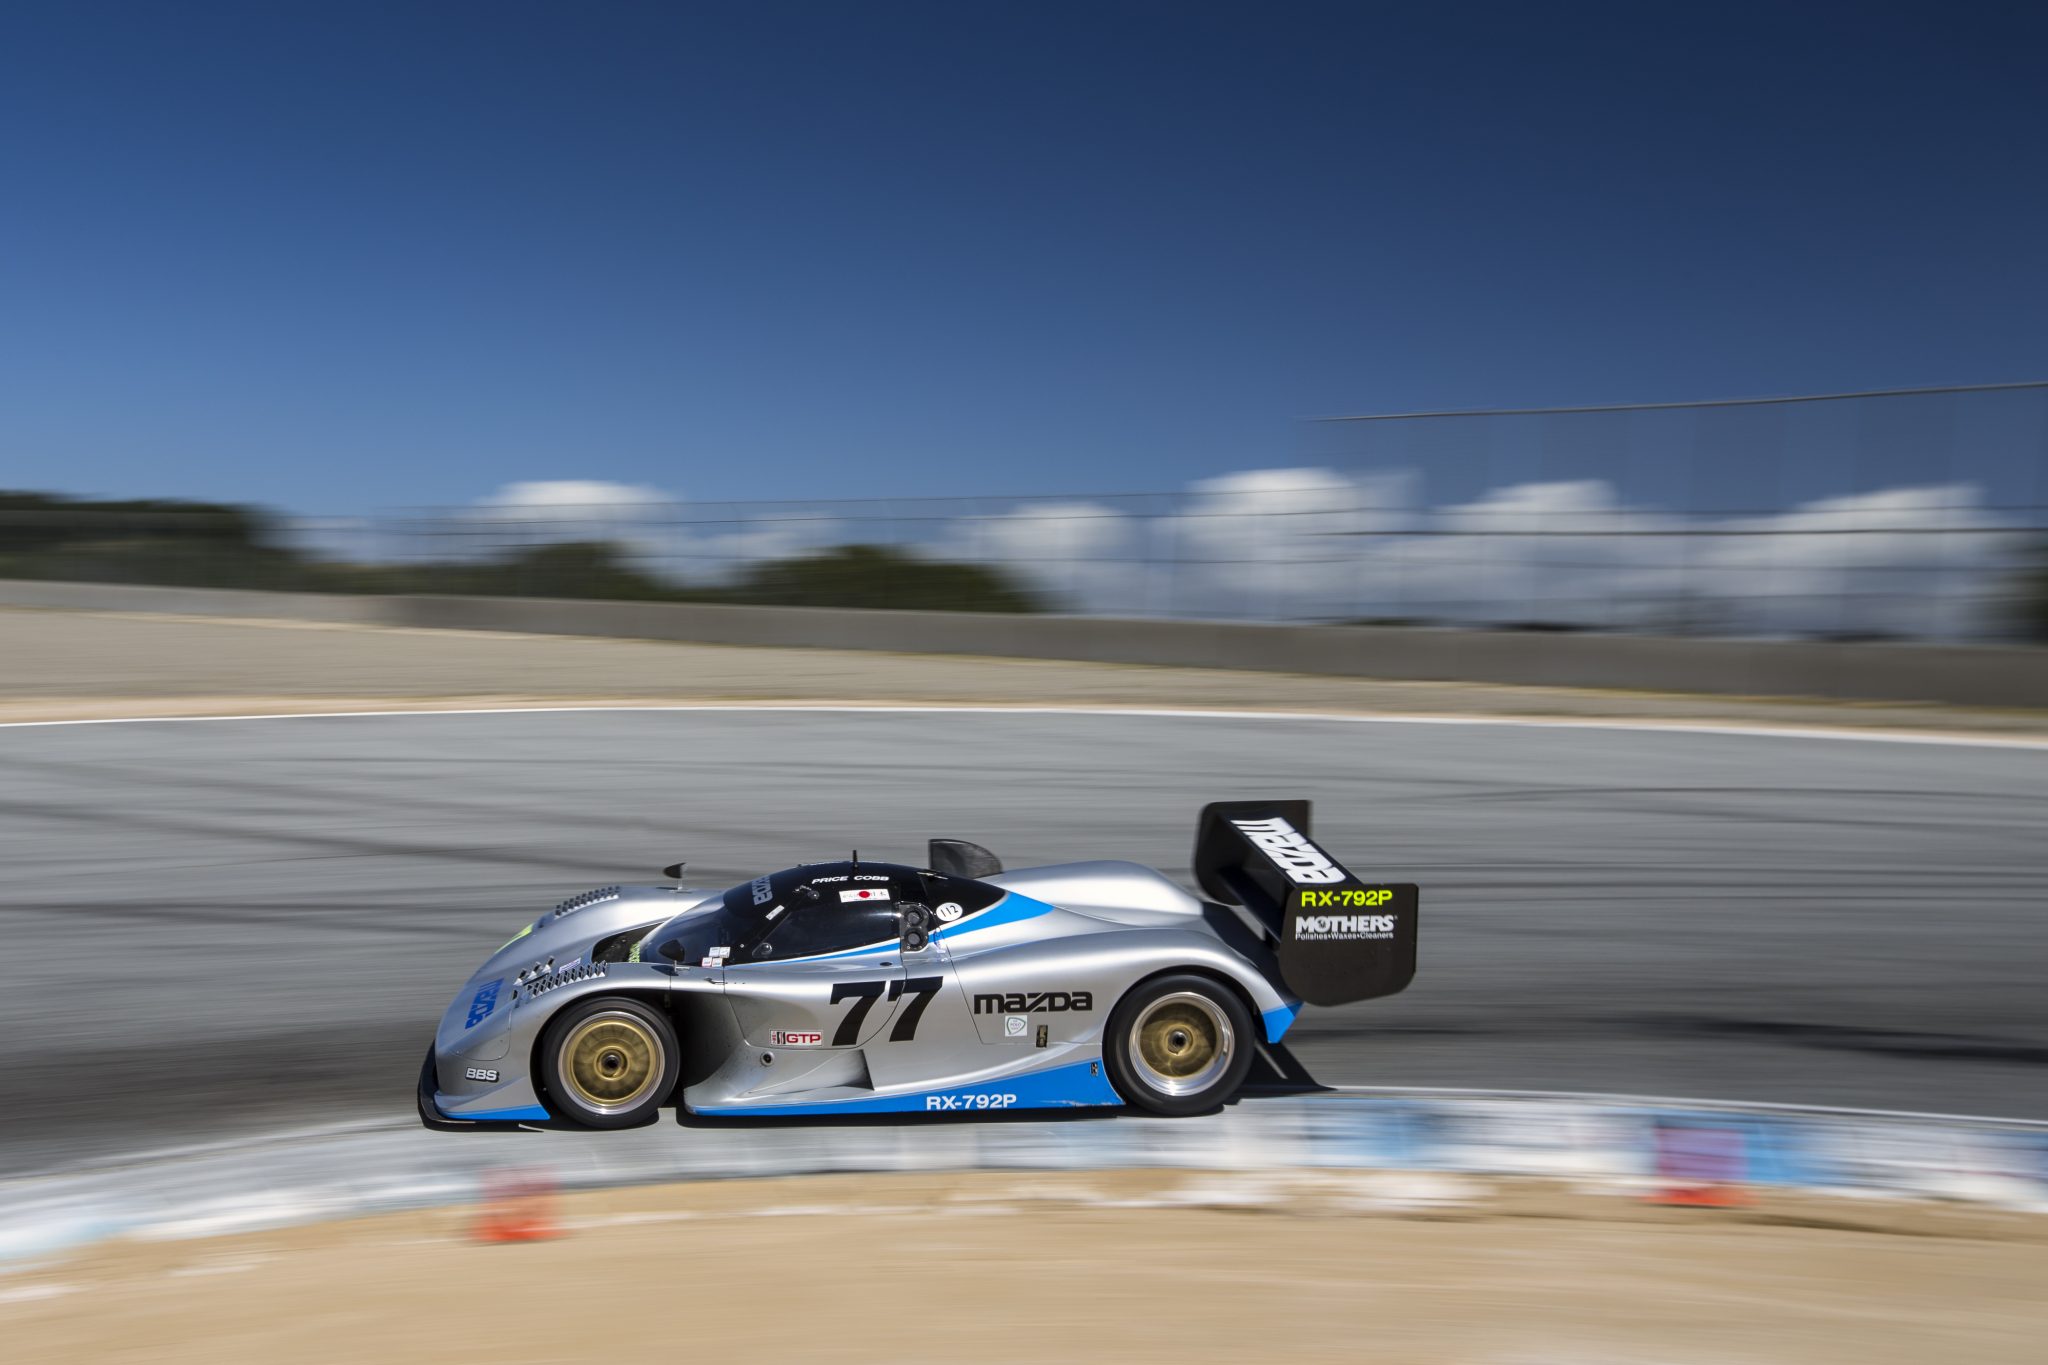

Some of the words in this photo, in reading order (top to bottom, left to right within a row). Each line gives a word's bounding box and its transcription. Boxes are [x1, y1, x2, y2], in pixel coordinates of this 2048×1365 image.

[812, 876, 849, 884] PRICE
[1301, 890, 1393, 907] RX-792P
[1295, 914, 1395, 933] MOTHERS
[830, 976, 944, 1046] 77
[974, 991, 1093, 1015] mazda
[786, 1033, 821, 1044] GTP
[465, 1067, 498, 1081] BBS
[926, 1093, 1017, 1110] RX-792P
